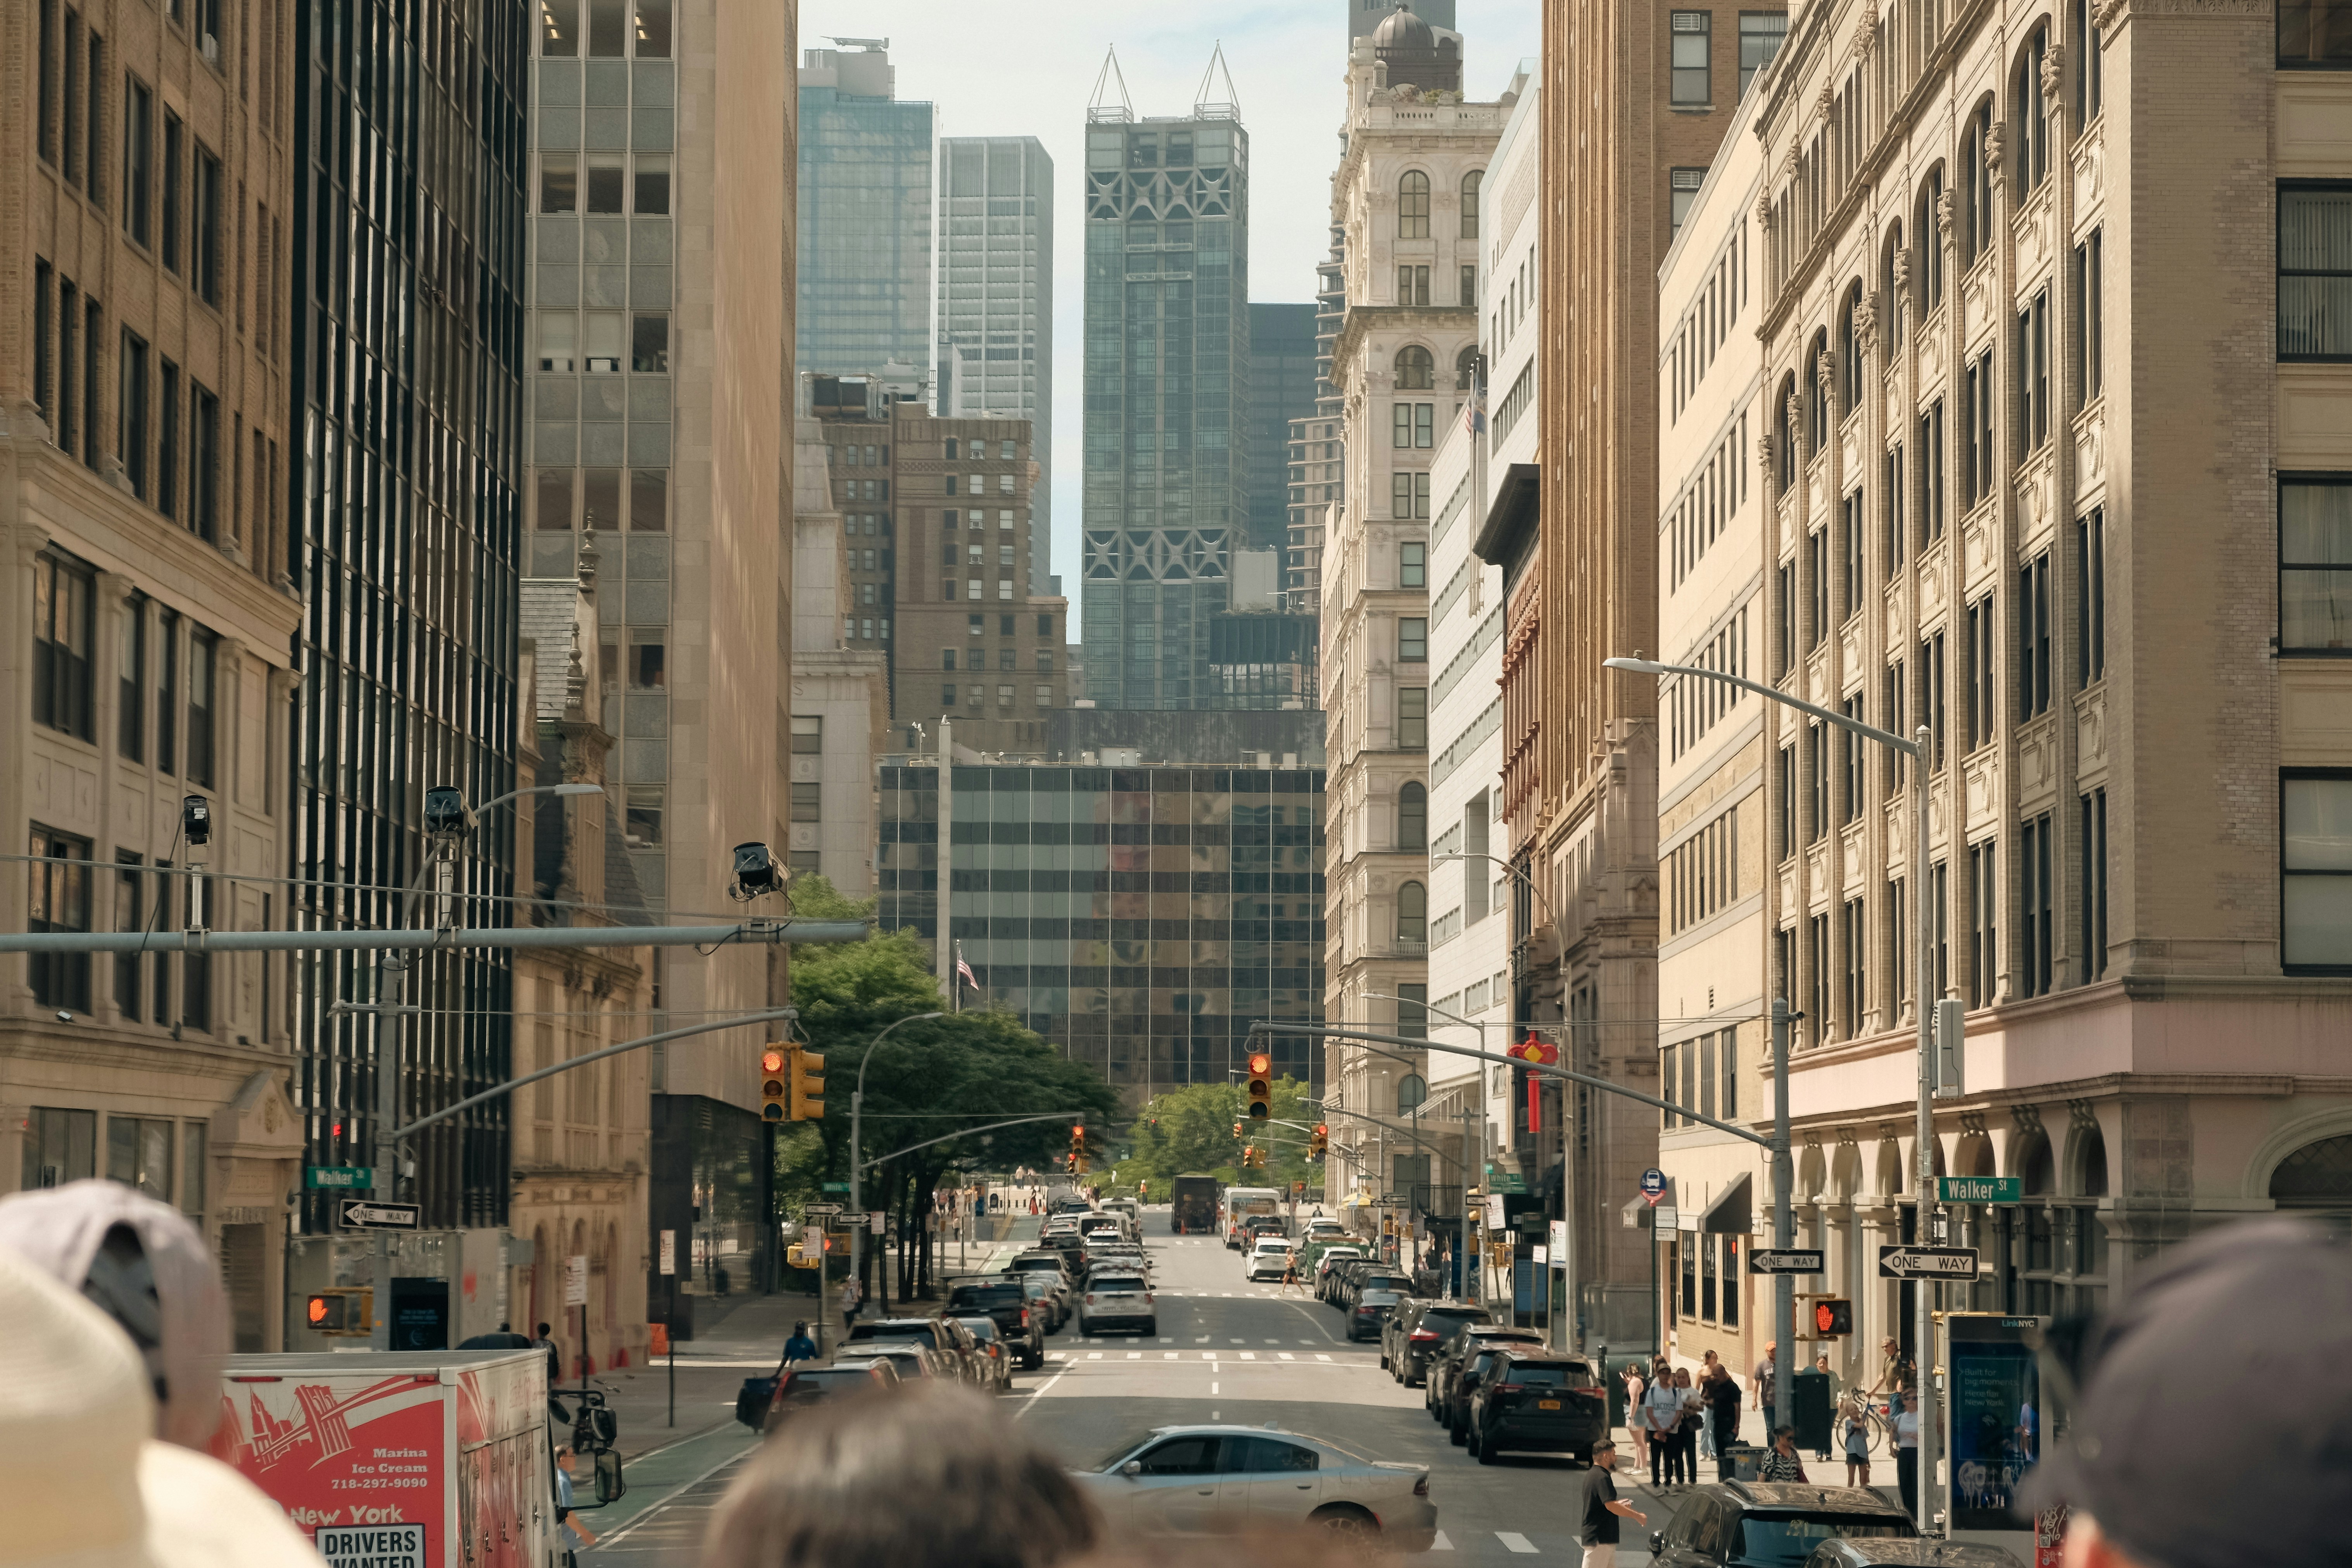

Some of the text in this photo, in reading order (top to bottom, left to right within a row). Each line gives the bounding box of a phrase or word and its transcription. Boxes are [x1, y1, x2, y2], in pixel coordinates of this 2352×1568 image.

[316, 1169, 364, 1185] Walker St
[1948, 1180, 2007, 1199] Walker St
[353, 1209, 408, 1222] ONE WAY
[1761, 1257, 1815, 1266] ONE WAY
[1893, 1256, 1969, 1270] ONE WAY
[1965, 1378, 1978, 1387] big
[373, 1448, 427, 1458] Marina
[352, 1463, 428, 1474] Ice Cream
[332, 1478, 427, 1489] 718-297-9090
[290, 1504, 404, 1526] New York
[325, 1531, 416, 1555] DRIVERS
[327, 1556, 414, 1568] WANTED
